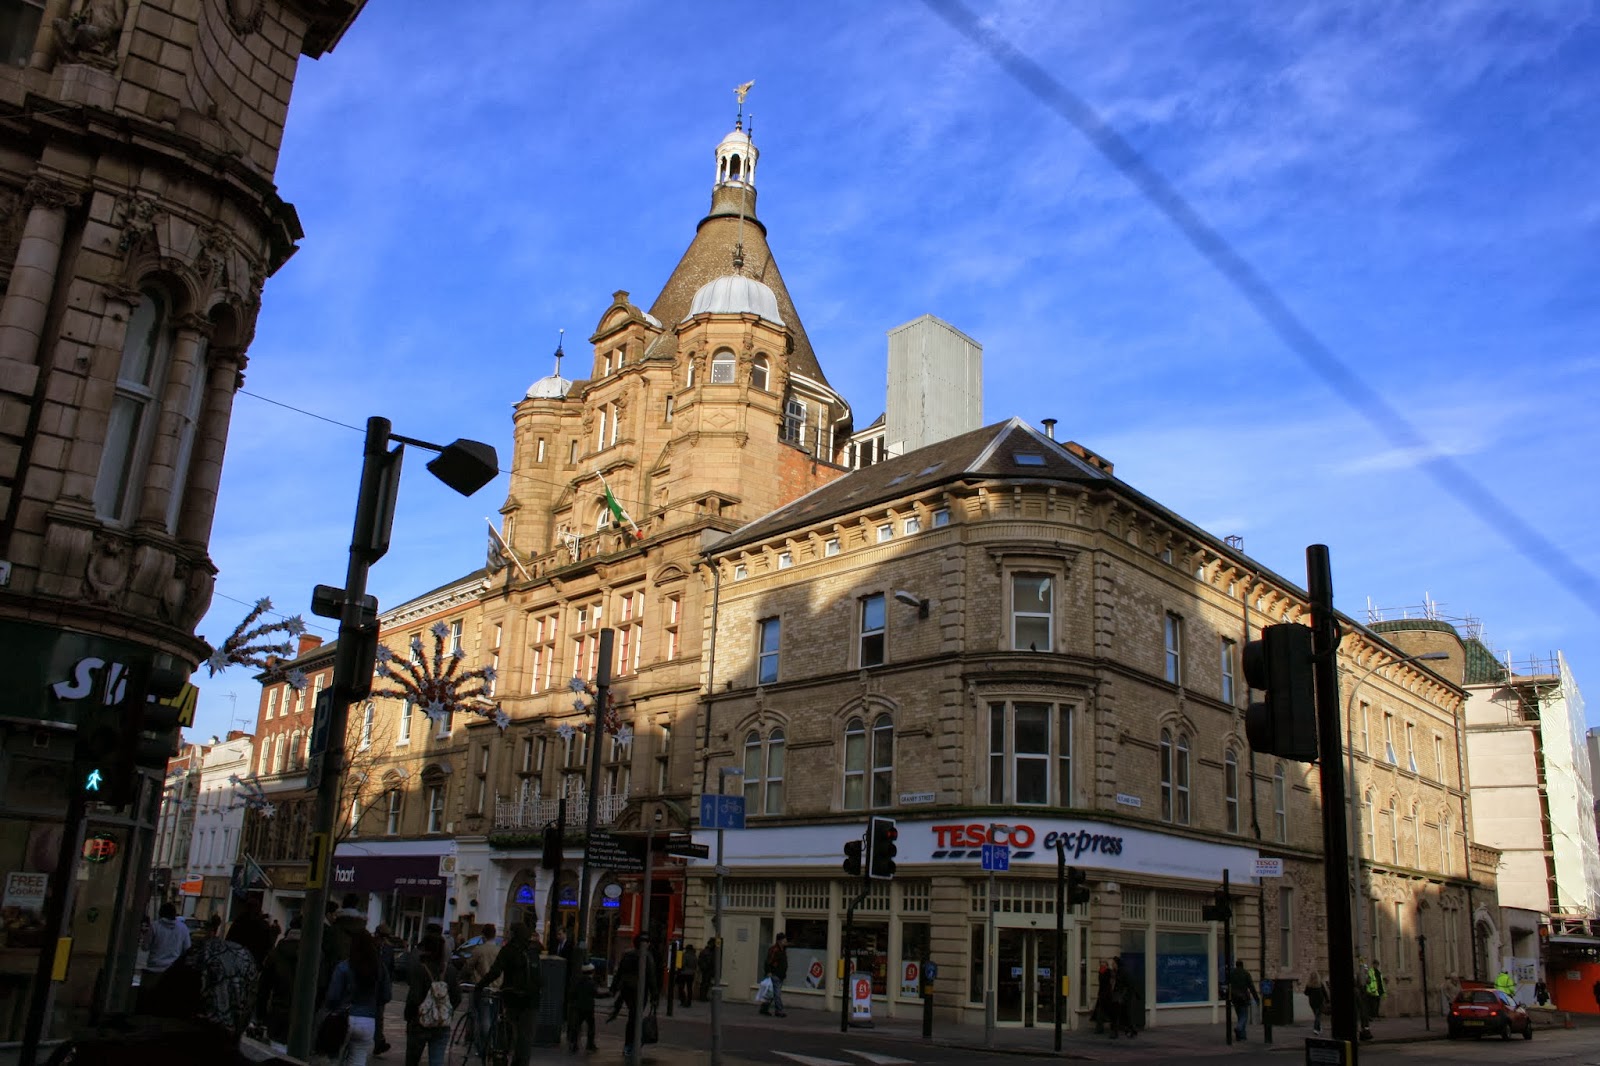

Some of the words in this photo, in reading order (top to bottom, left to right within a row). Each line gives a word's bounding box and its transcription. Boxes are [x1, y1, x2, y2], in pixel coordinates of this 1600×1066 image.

[932, 824, 1036, 848] TESCO
[1043, 829, 1123, 859] express
[334, 864, 355, 882] haart
[10, 875, 45, 887] FREE
[8, 886, 43, 896] Cookie
